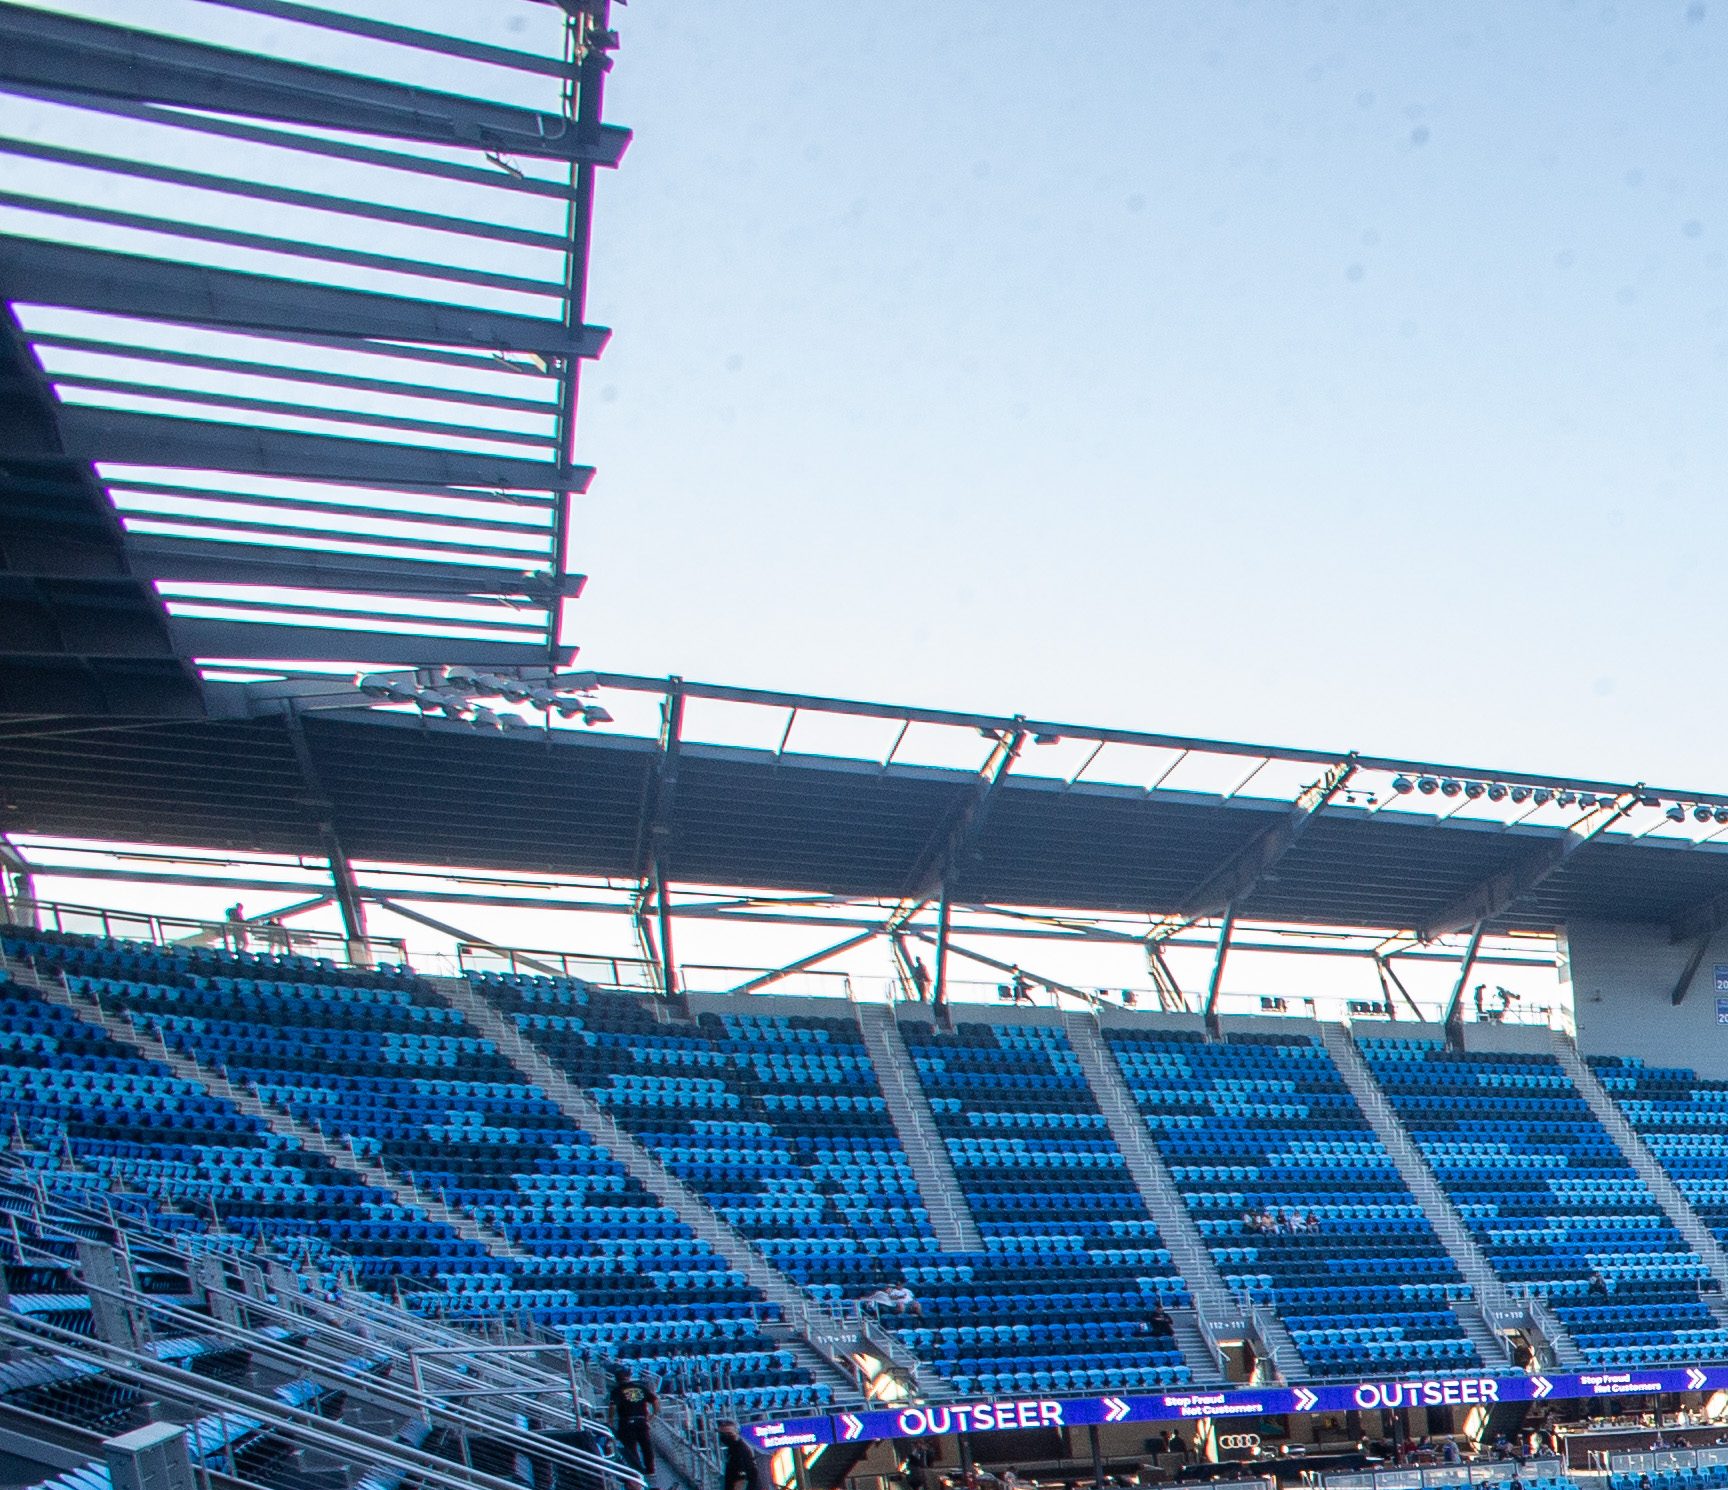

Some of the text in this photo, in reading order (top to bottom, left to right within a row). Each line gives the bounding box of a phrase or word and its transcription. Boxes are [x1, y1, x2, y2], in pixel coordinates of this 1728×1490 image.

[1209, 1321, 1245, 1330] 112 111
[1580, 1373, 1631, 1385] Stop Fraud
[1354, 1379, 1500, 1409] OUTSEER
[1594, 1382, 1662, 1393] Not Customers
[1164, 1393, 1225, 1407] Stop Fraud
[1180, 1403, 1262, 1416] Not Customers
[899, 1401, 1066, 1437] OUTSEER
